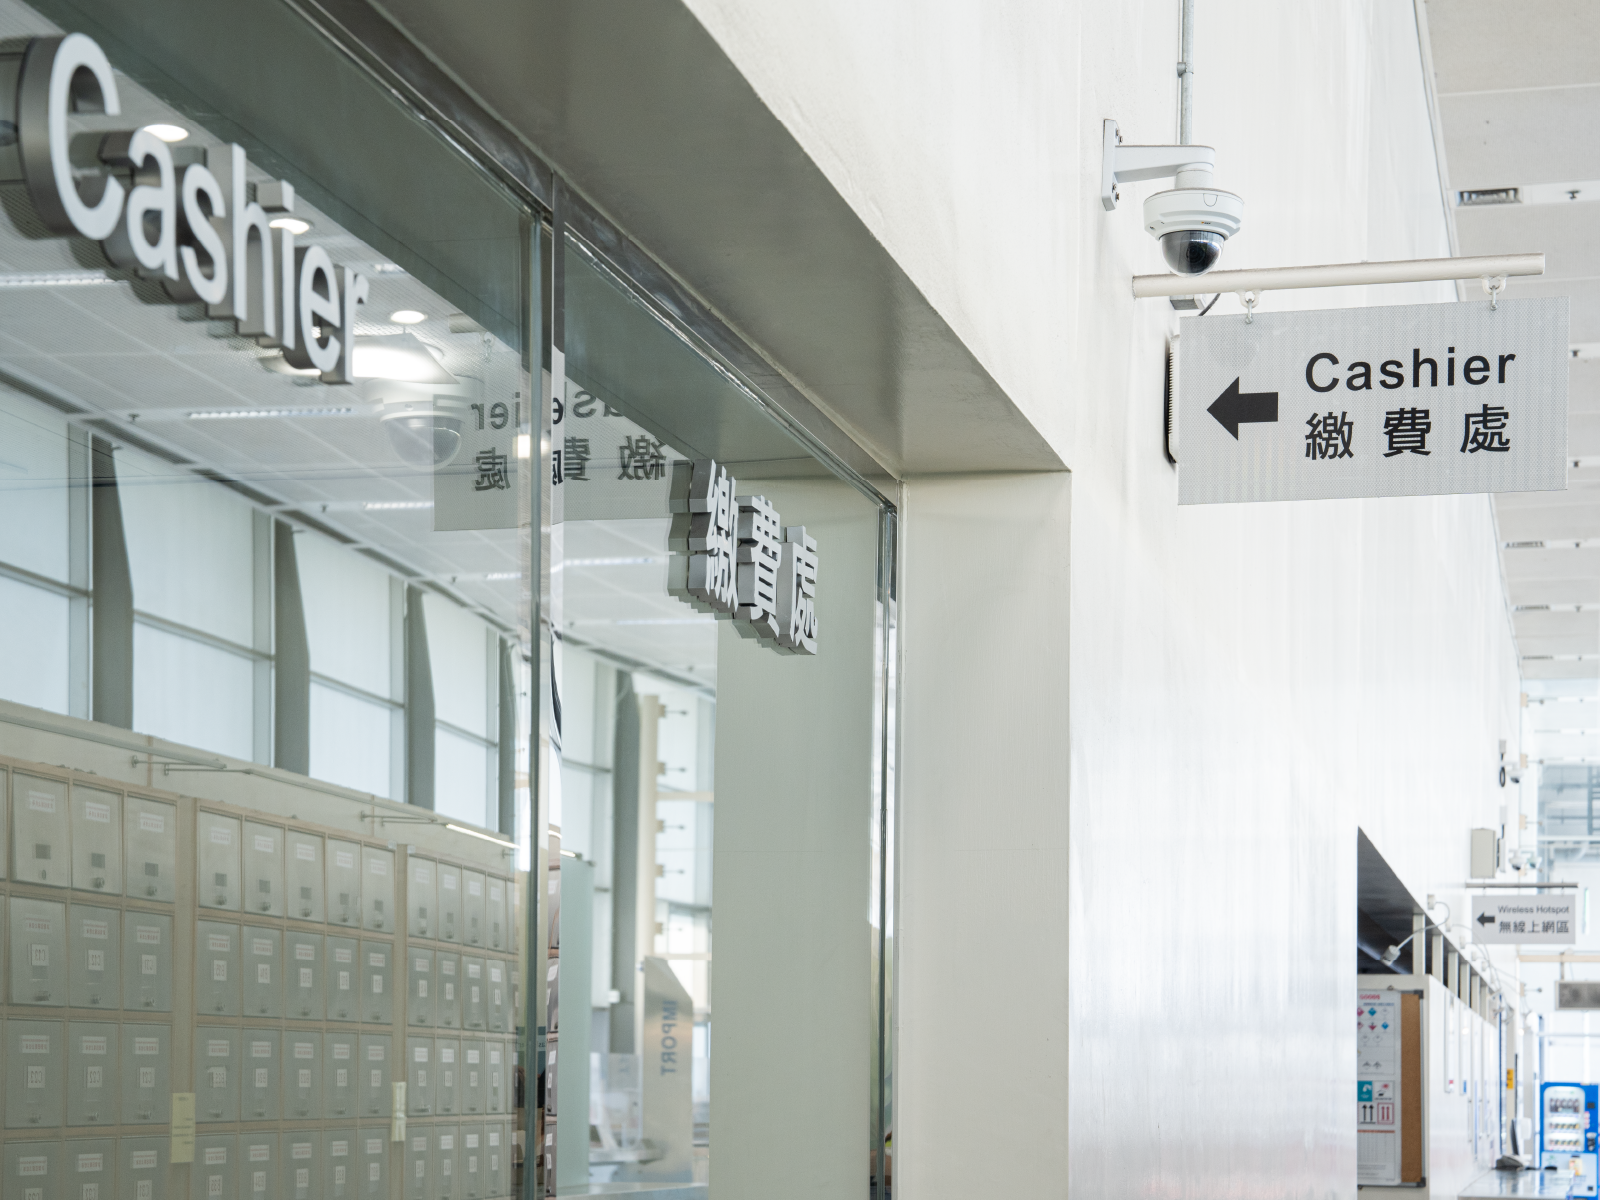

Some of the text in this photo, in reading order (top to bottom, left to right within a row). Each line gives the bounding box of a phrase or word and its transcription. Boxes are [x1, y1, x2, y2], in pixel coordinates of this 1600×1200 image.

[48, 31, 370, 383] Cashier
[1305, 346, 1517, 394] Cashier
[1304, 403, 1511, 461] 繳費處
[705, 458, 819, 655] 繳費處
[1497, 905, 1570, 916] Wireless Hotspot
